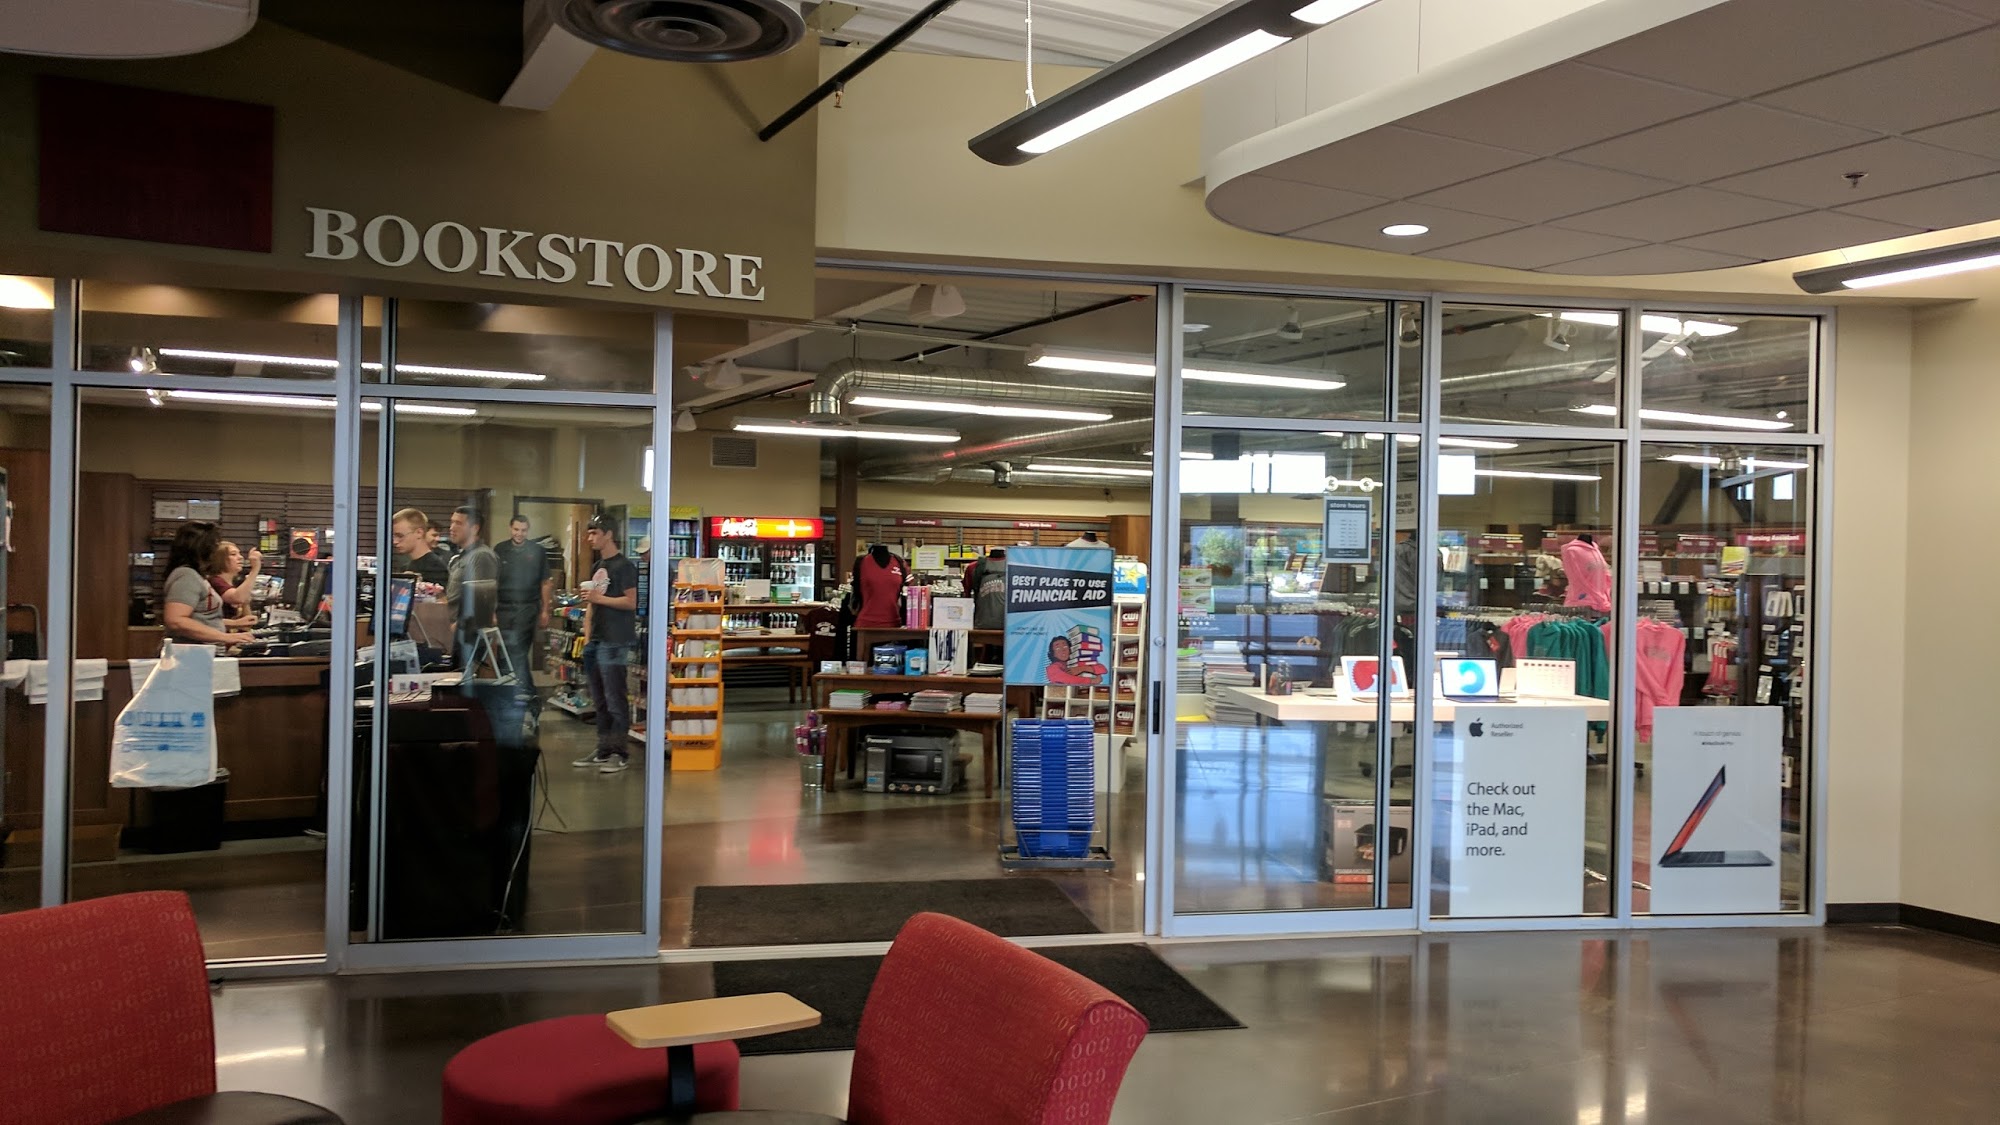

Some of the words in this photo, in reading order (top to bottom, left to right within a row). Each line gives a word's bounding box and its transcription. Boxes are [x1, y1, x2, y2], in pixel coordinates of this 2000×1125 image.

[305, 206, 765, 301] BOOKSTORE
[1012, 575, 1038, 586] BEST
[1039, 576, 1070, 587] PLACE
[1072, 578, 1086, 588] TO
[1088, 579, 1107, 588] USE
[1011, 588, 1078, 603] FINANCIAL
[1082, 590, 1107, 600] AID
[1122, 612, 1139, 620] CWI
[1123, 647, 1138, 655] CWI
[1117, 711, 1134, 719] CWI
[1467, 782, 1509, 795] Check
[1512, 784, 1535, 795] out
[1467, 802, 1489, 815] the
[1493, 803, 1524, 817] Mac,
[1466, 822, 1498, 837] iPad,
[1502, 822, 1527, 836] and
[1466, 846, 1505, 856] more.
